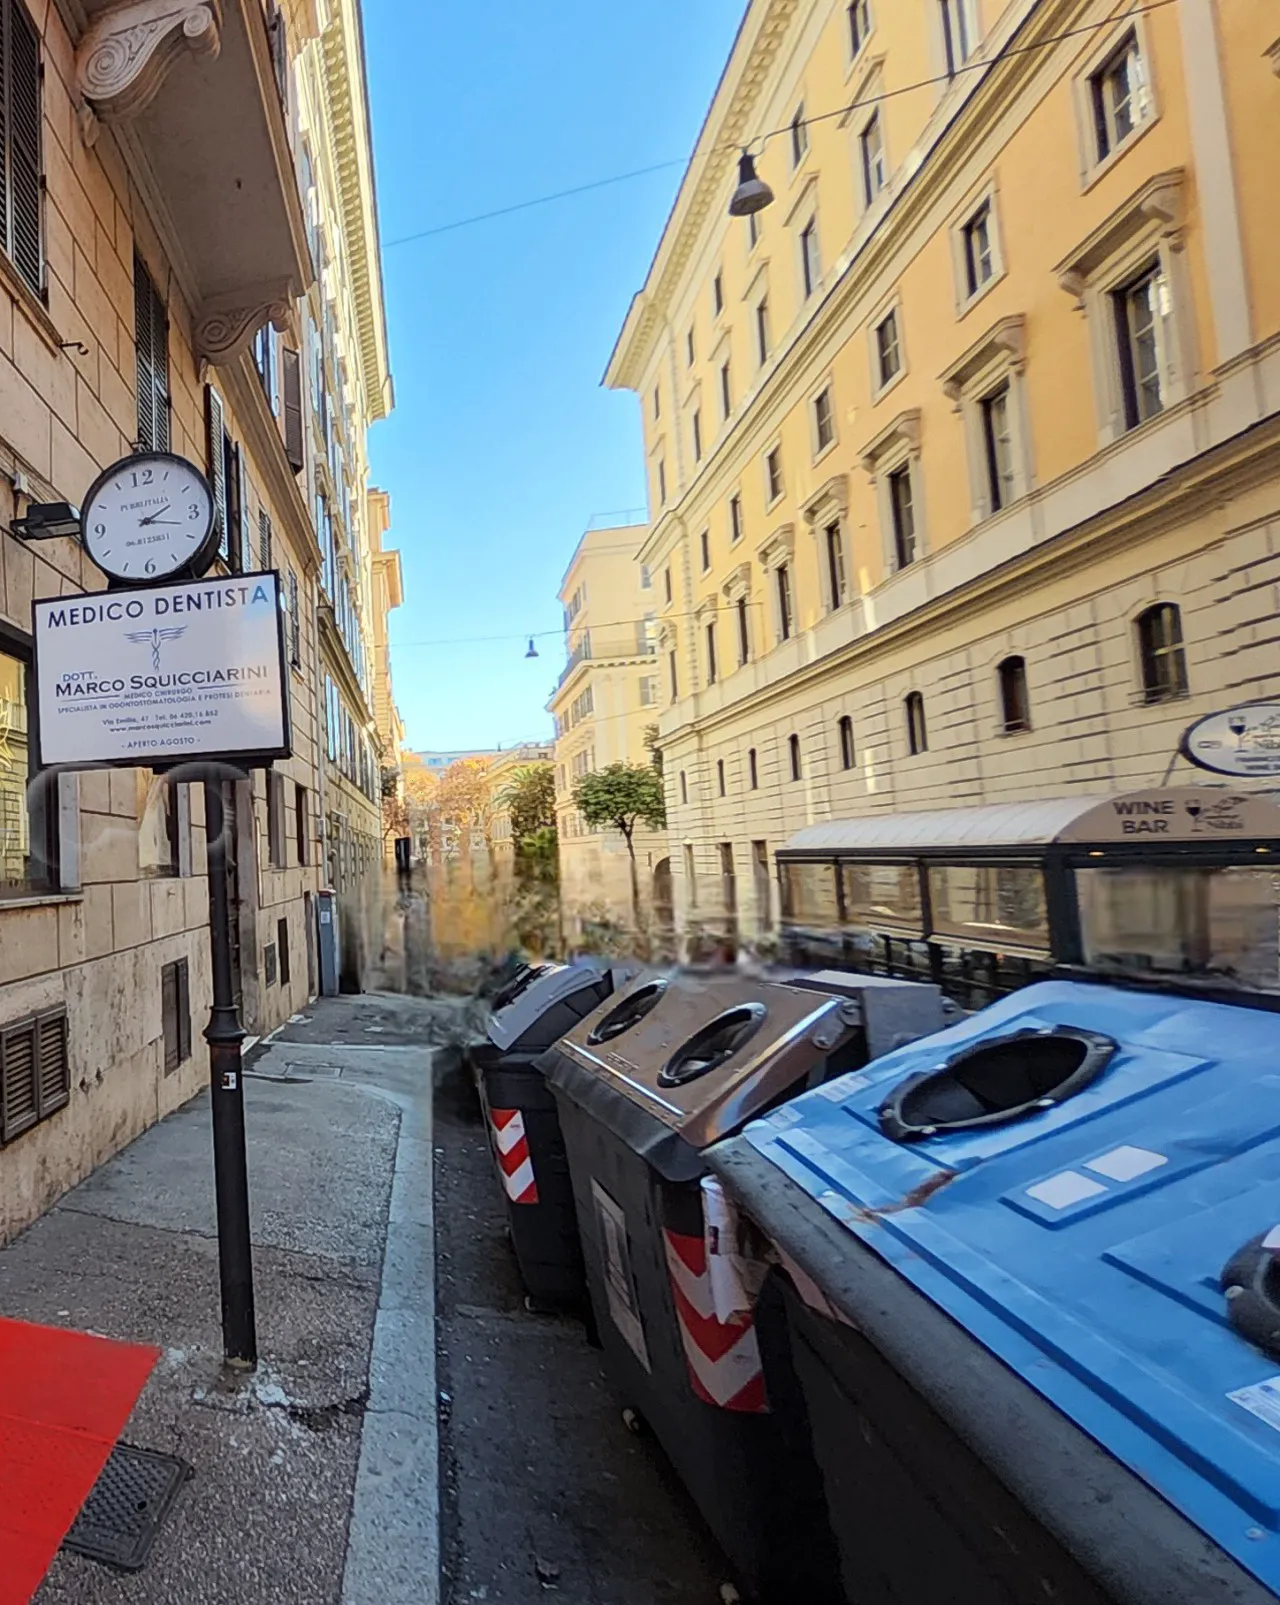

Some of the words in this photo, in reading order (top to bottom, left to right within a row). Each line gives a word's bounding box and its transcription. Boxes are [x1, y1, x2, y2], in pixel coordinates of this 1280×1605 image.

[130, 469, 154, 488] 12
[94, 523, 106, 539] 9
[188, 503, 200, 520] 3
[144, 558, 156, 574] 6
[48, 600, 144, 628] MEDICO
[155, 584, 269, 616] DENTISTA
[56, 679, 125, 697] MARCO
[130, 665, 268, 689] SQUICCIARINI
[62, 671, 98, 682] DOTT.
[124, 691, 153, 699] MEDICO
[58, 704, 98, 714] SPECIALISTA
[127, 739, 157, 748] APERTO
[160, 737, 195, 746] AGOSTO
[1113, 800, 1175, 815] WINE
[1122, 819, 1169, 834] BAR
